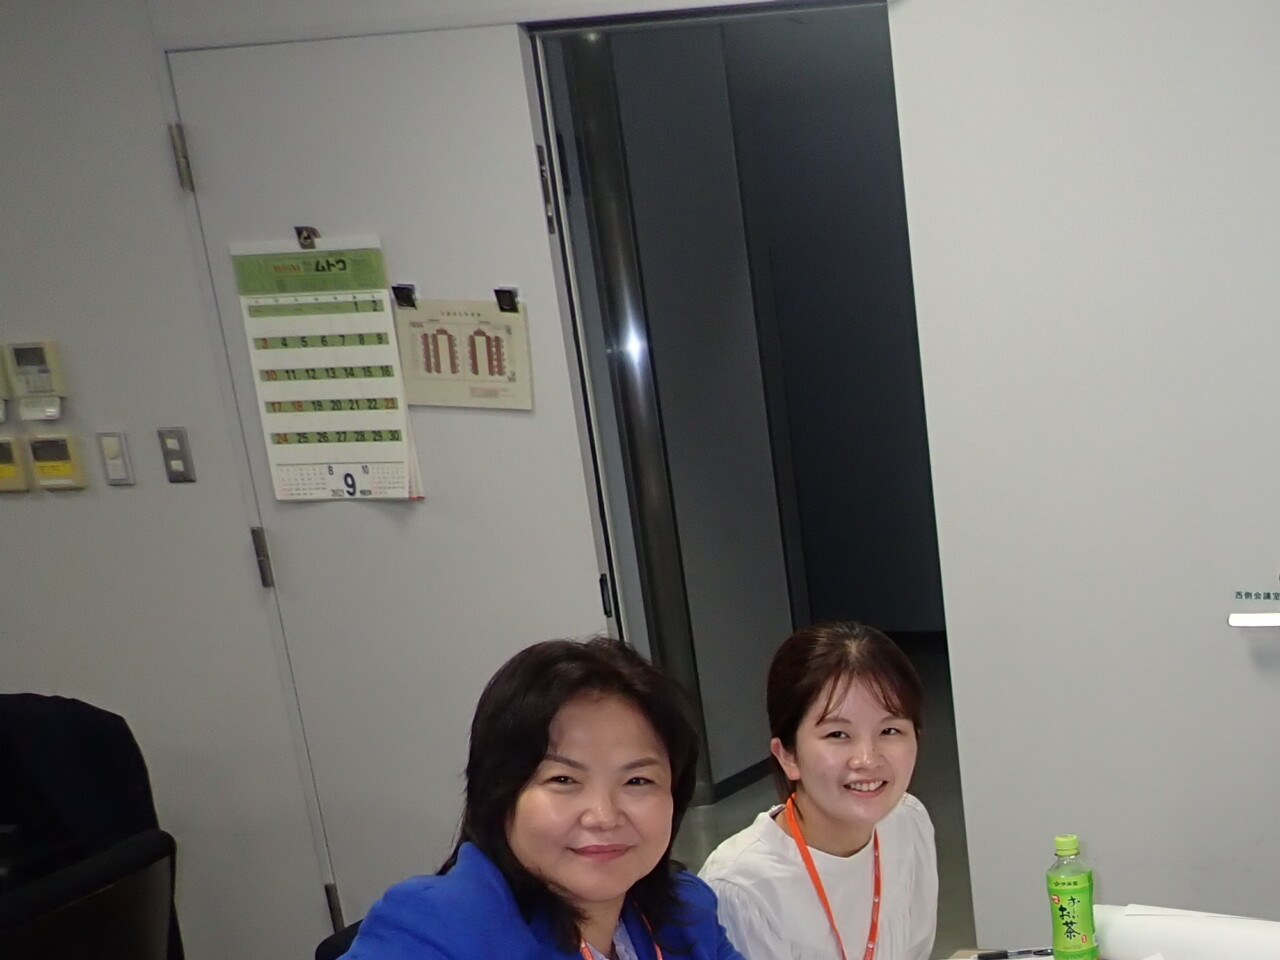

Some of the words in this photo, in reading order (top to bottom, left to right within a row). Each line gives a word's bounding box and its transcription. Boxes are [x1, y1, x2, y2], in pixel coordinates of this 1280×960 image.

[354, 301, 360, 312] 1
[372, 300, 378, 312] 2
[344, 472, 356, 497] 9
